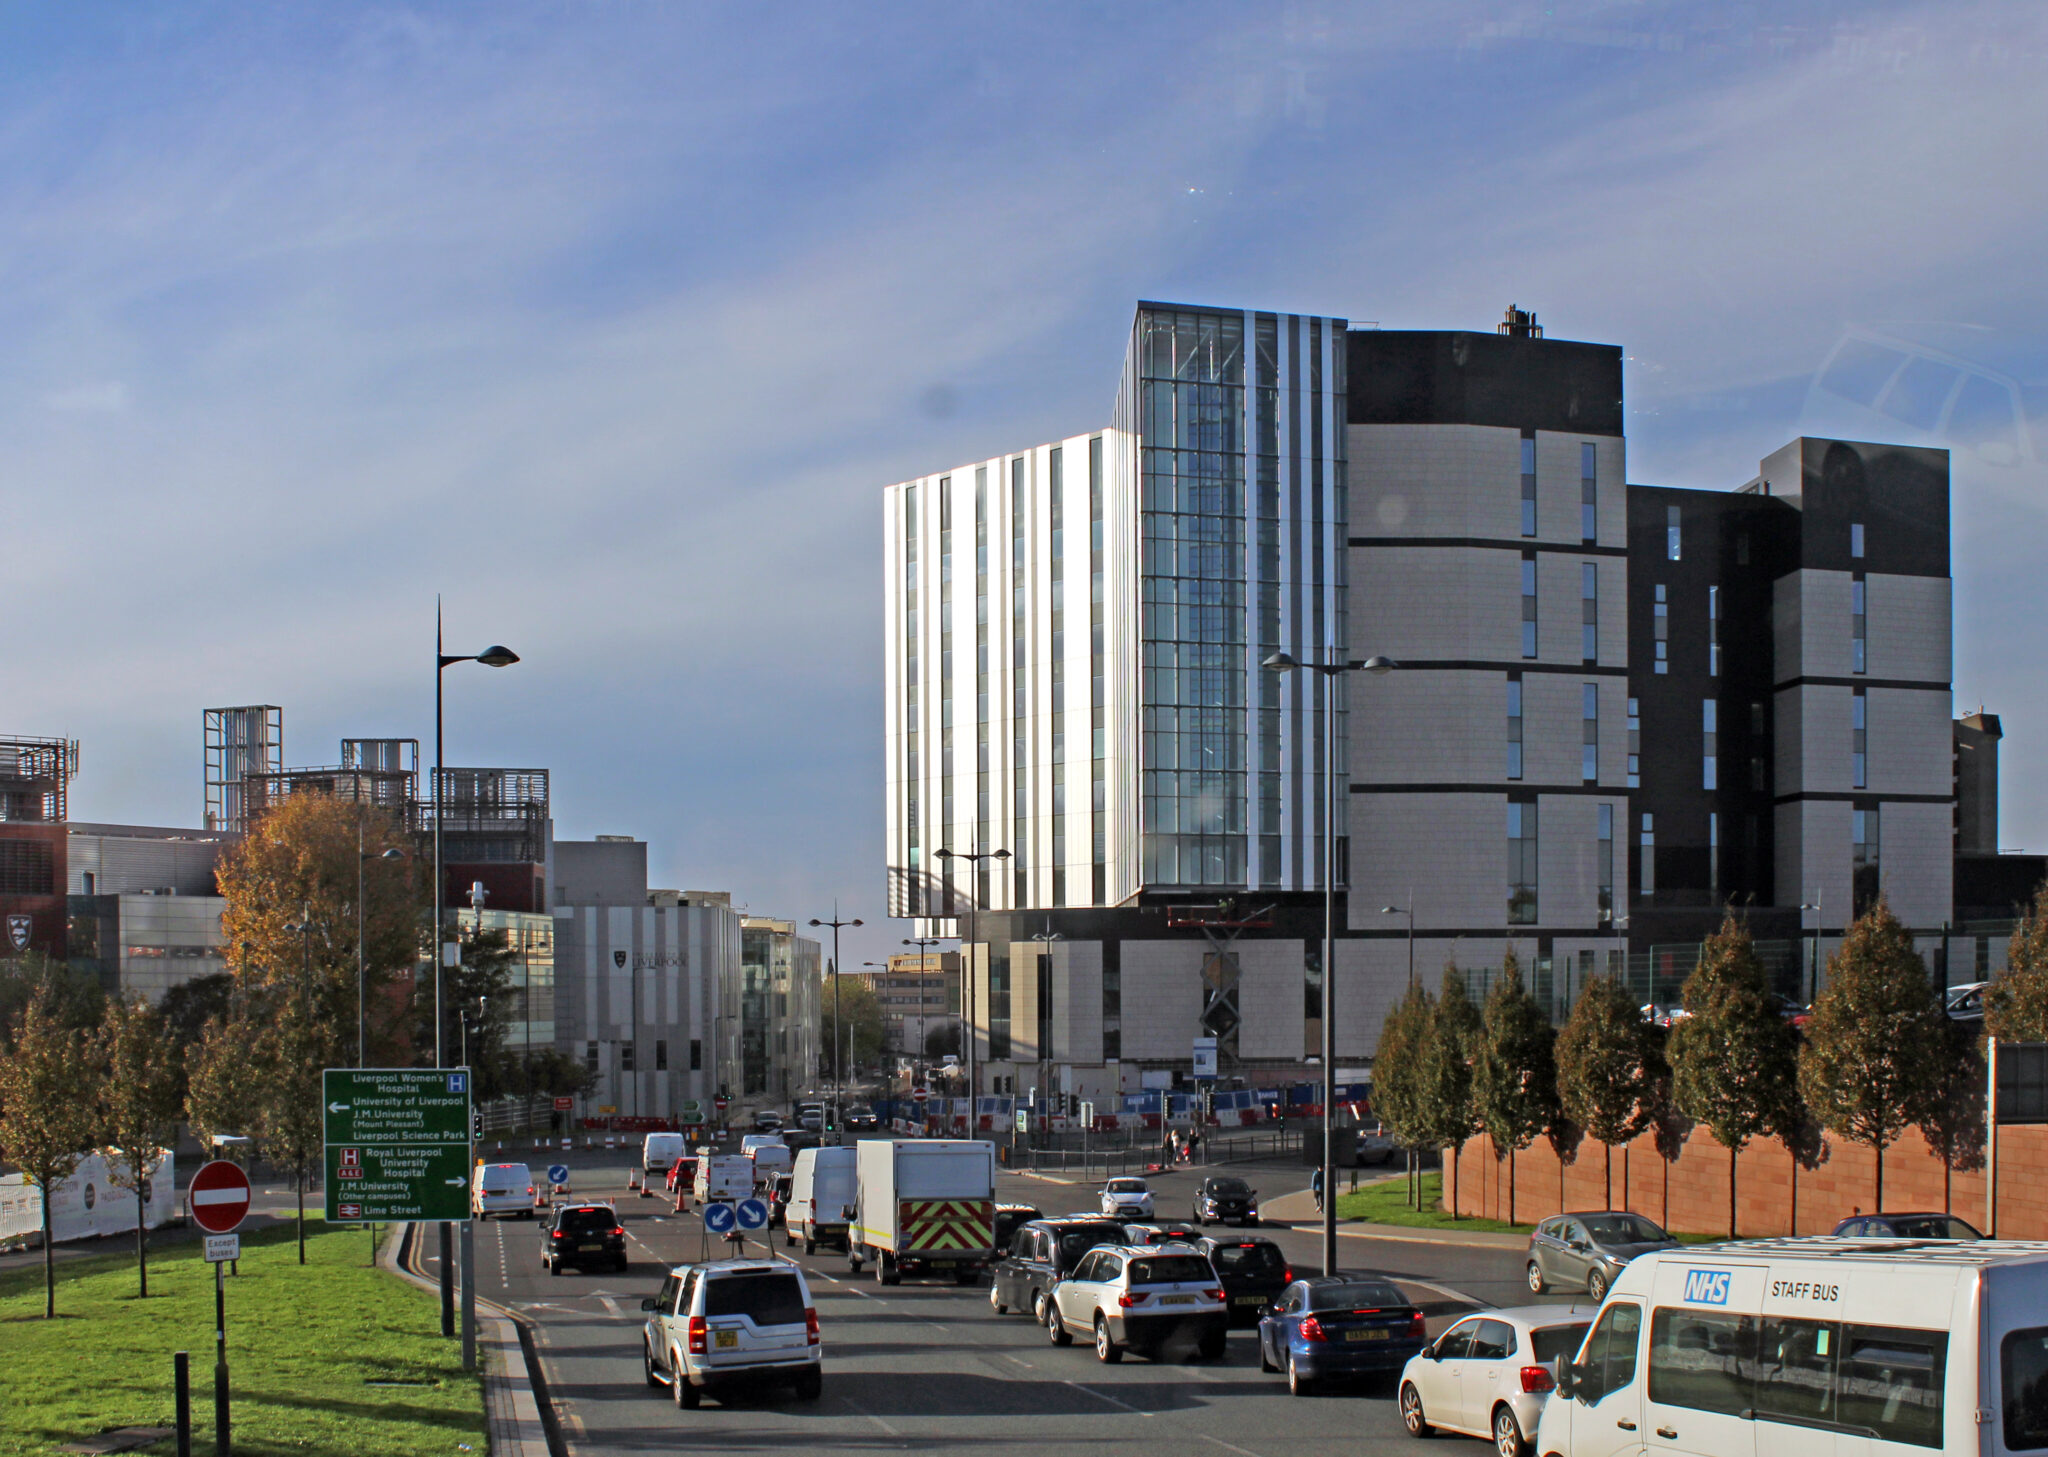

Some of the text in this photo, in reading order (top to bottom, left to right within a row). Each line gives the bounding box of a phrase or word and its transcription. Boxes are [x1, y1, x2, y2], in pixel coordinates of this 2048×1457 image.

[632, 958, 688, 968] LIVERPOOL
[353, 1074, 444, 1083] Liverpool Women's
[450, 1076, 463, 1091] H
[378, 1084, 419, 1094] Hospital
[353, 1097, 464, 1107] University of Liverpool
[354, 1131, 465, 1141] Liverpool Science Park
[344, 1150, 357, 1165] H
[366, 1147, 442, 1158] Royal Liverpool
[380, 1158, 429, 1168] University
[384, 1168, 425, 1178] Hospital
[365, 1205, 422, 1214] Lime Street
[208, 1238, 236, 1247] Except
[210, 1249, 233, 1257] buses
[1685, 1271, 1729, 1303] NHS
[1772, 1280, 1839, 1301] STAFF BUS
